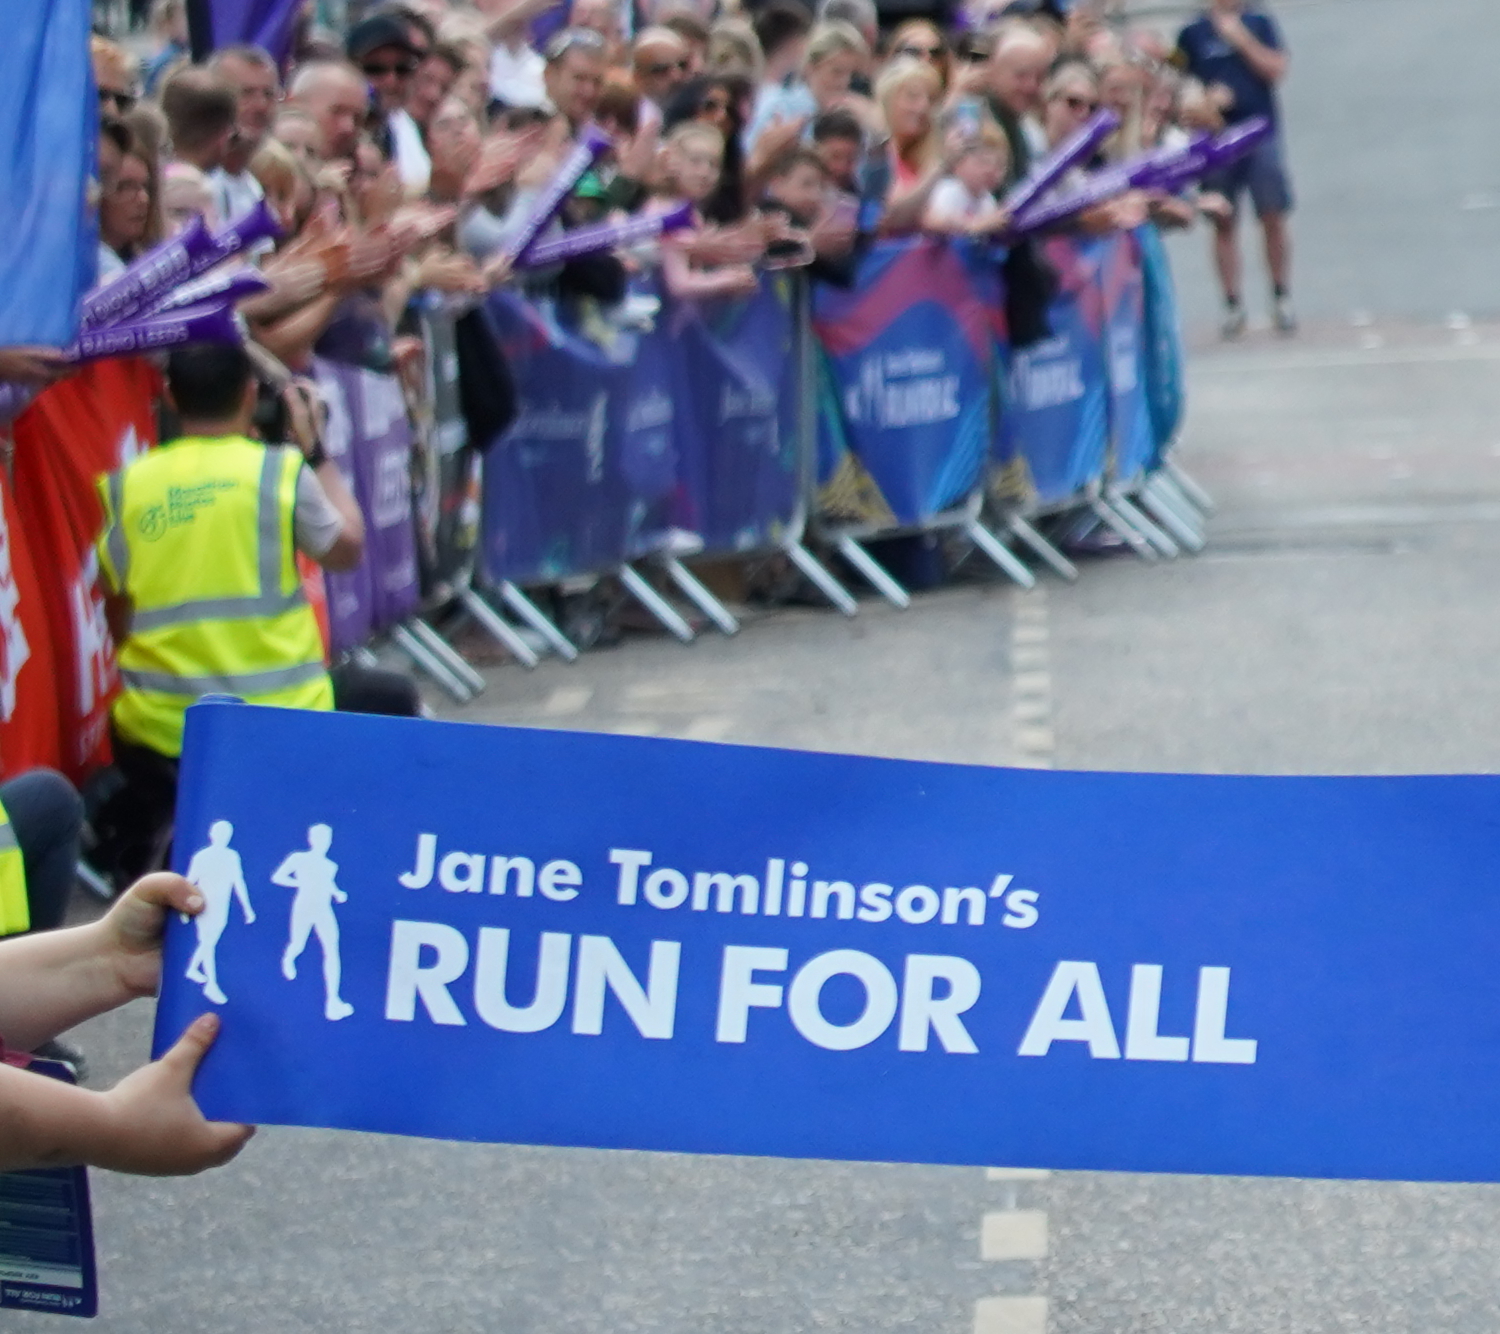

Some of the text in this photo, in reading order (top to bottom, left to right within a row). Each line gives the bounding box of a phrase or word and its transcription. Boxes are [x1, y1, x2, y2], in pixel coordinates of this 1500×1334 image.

[399, 832, 1042, 930] Jane Tomlinson's
[385, 919, 1258, 1065] RUN FOR ALL
